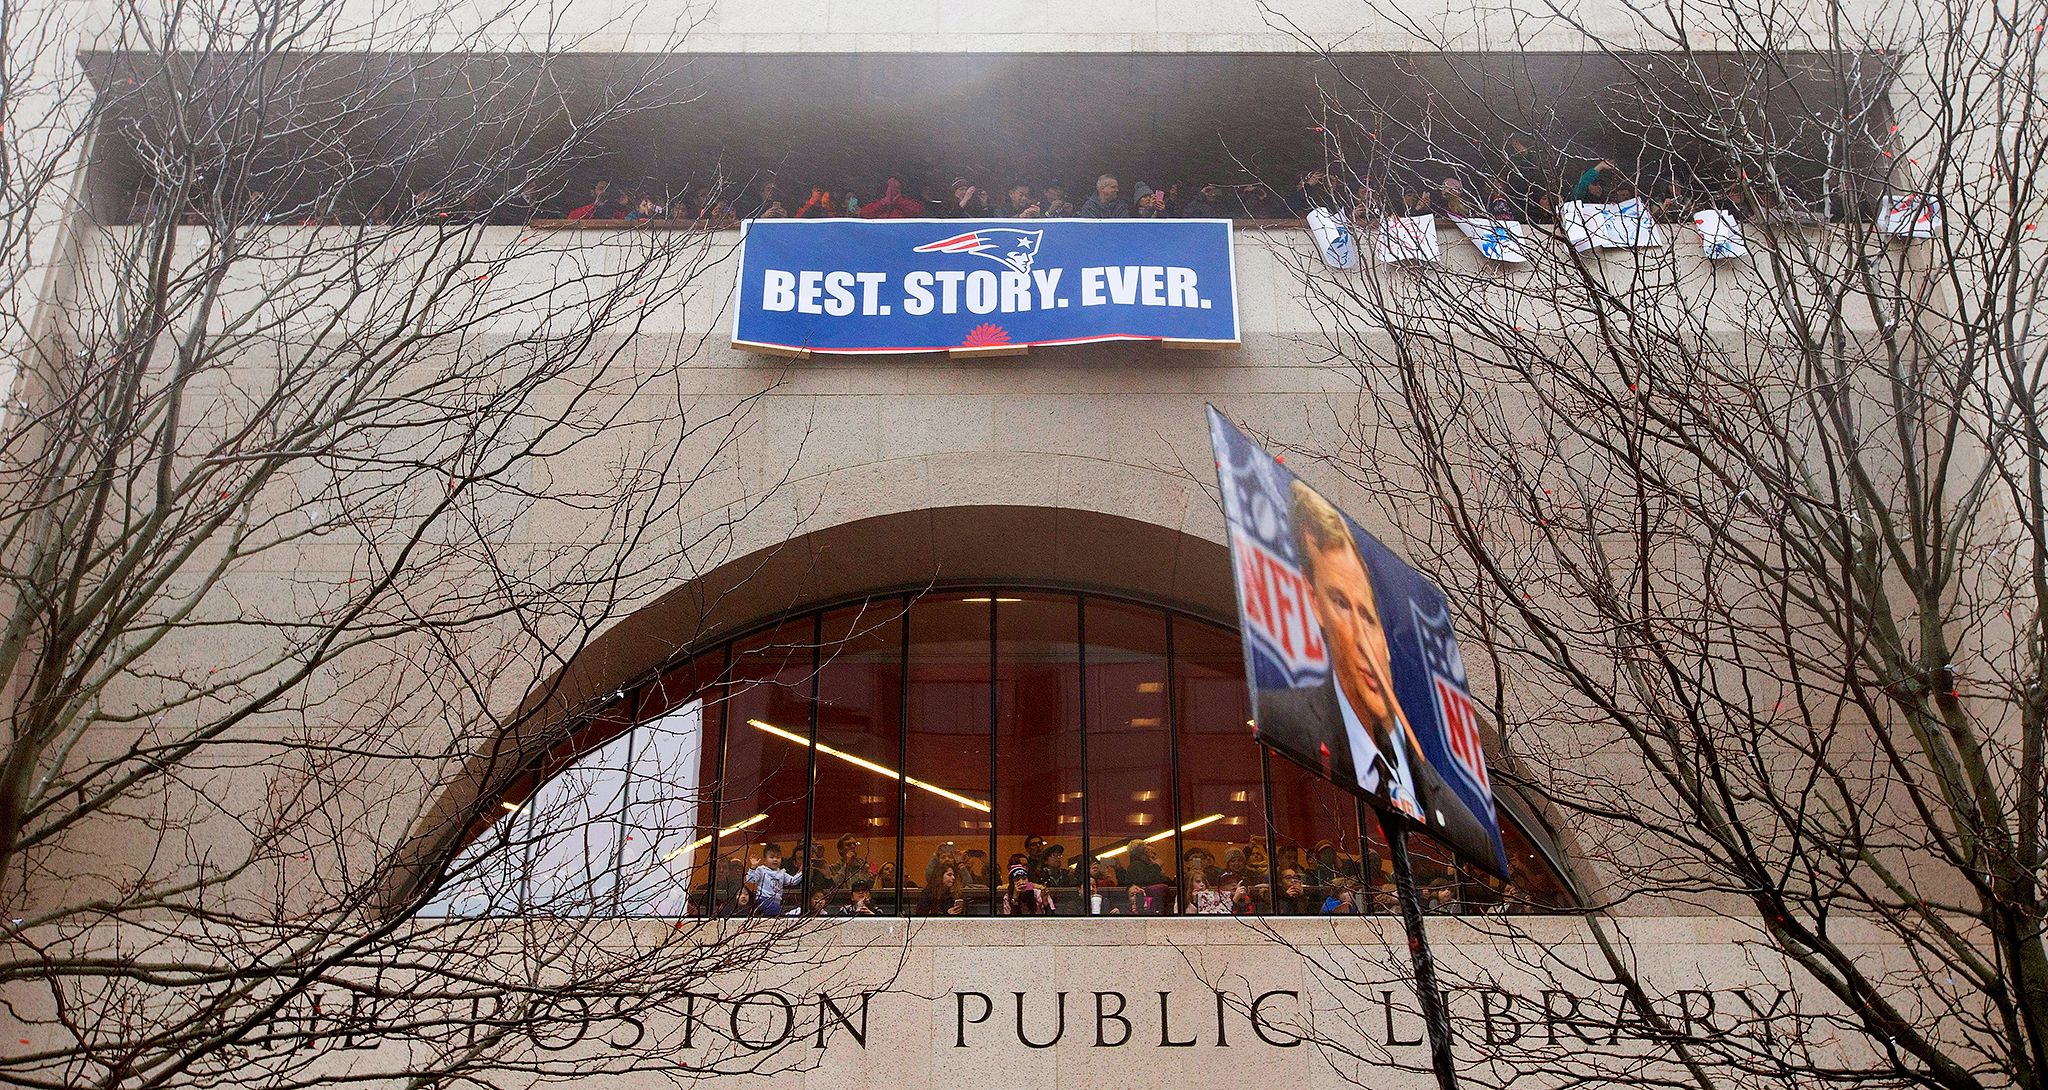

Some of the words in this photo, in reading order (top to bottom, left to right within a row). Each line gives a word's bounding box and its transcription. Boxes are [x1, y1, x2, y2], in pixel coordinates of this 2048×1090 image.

[762, 268, 891, 316] BEST.
[902, 267, 1069, 314] STORY.
[1081, 265, 1213, 310] EVER.
[1233, 536, 1325, 662] NFL
[954, 990, 1302, 1048] PUBLIC
[1380, 990, 1790, 1047] LIBRARY
